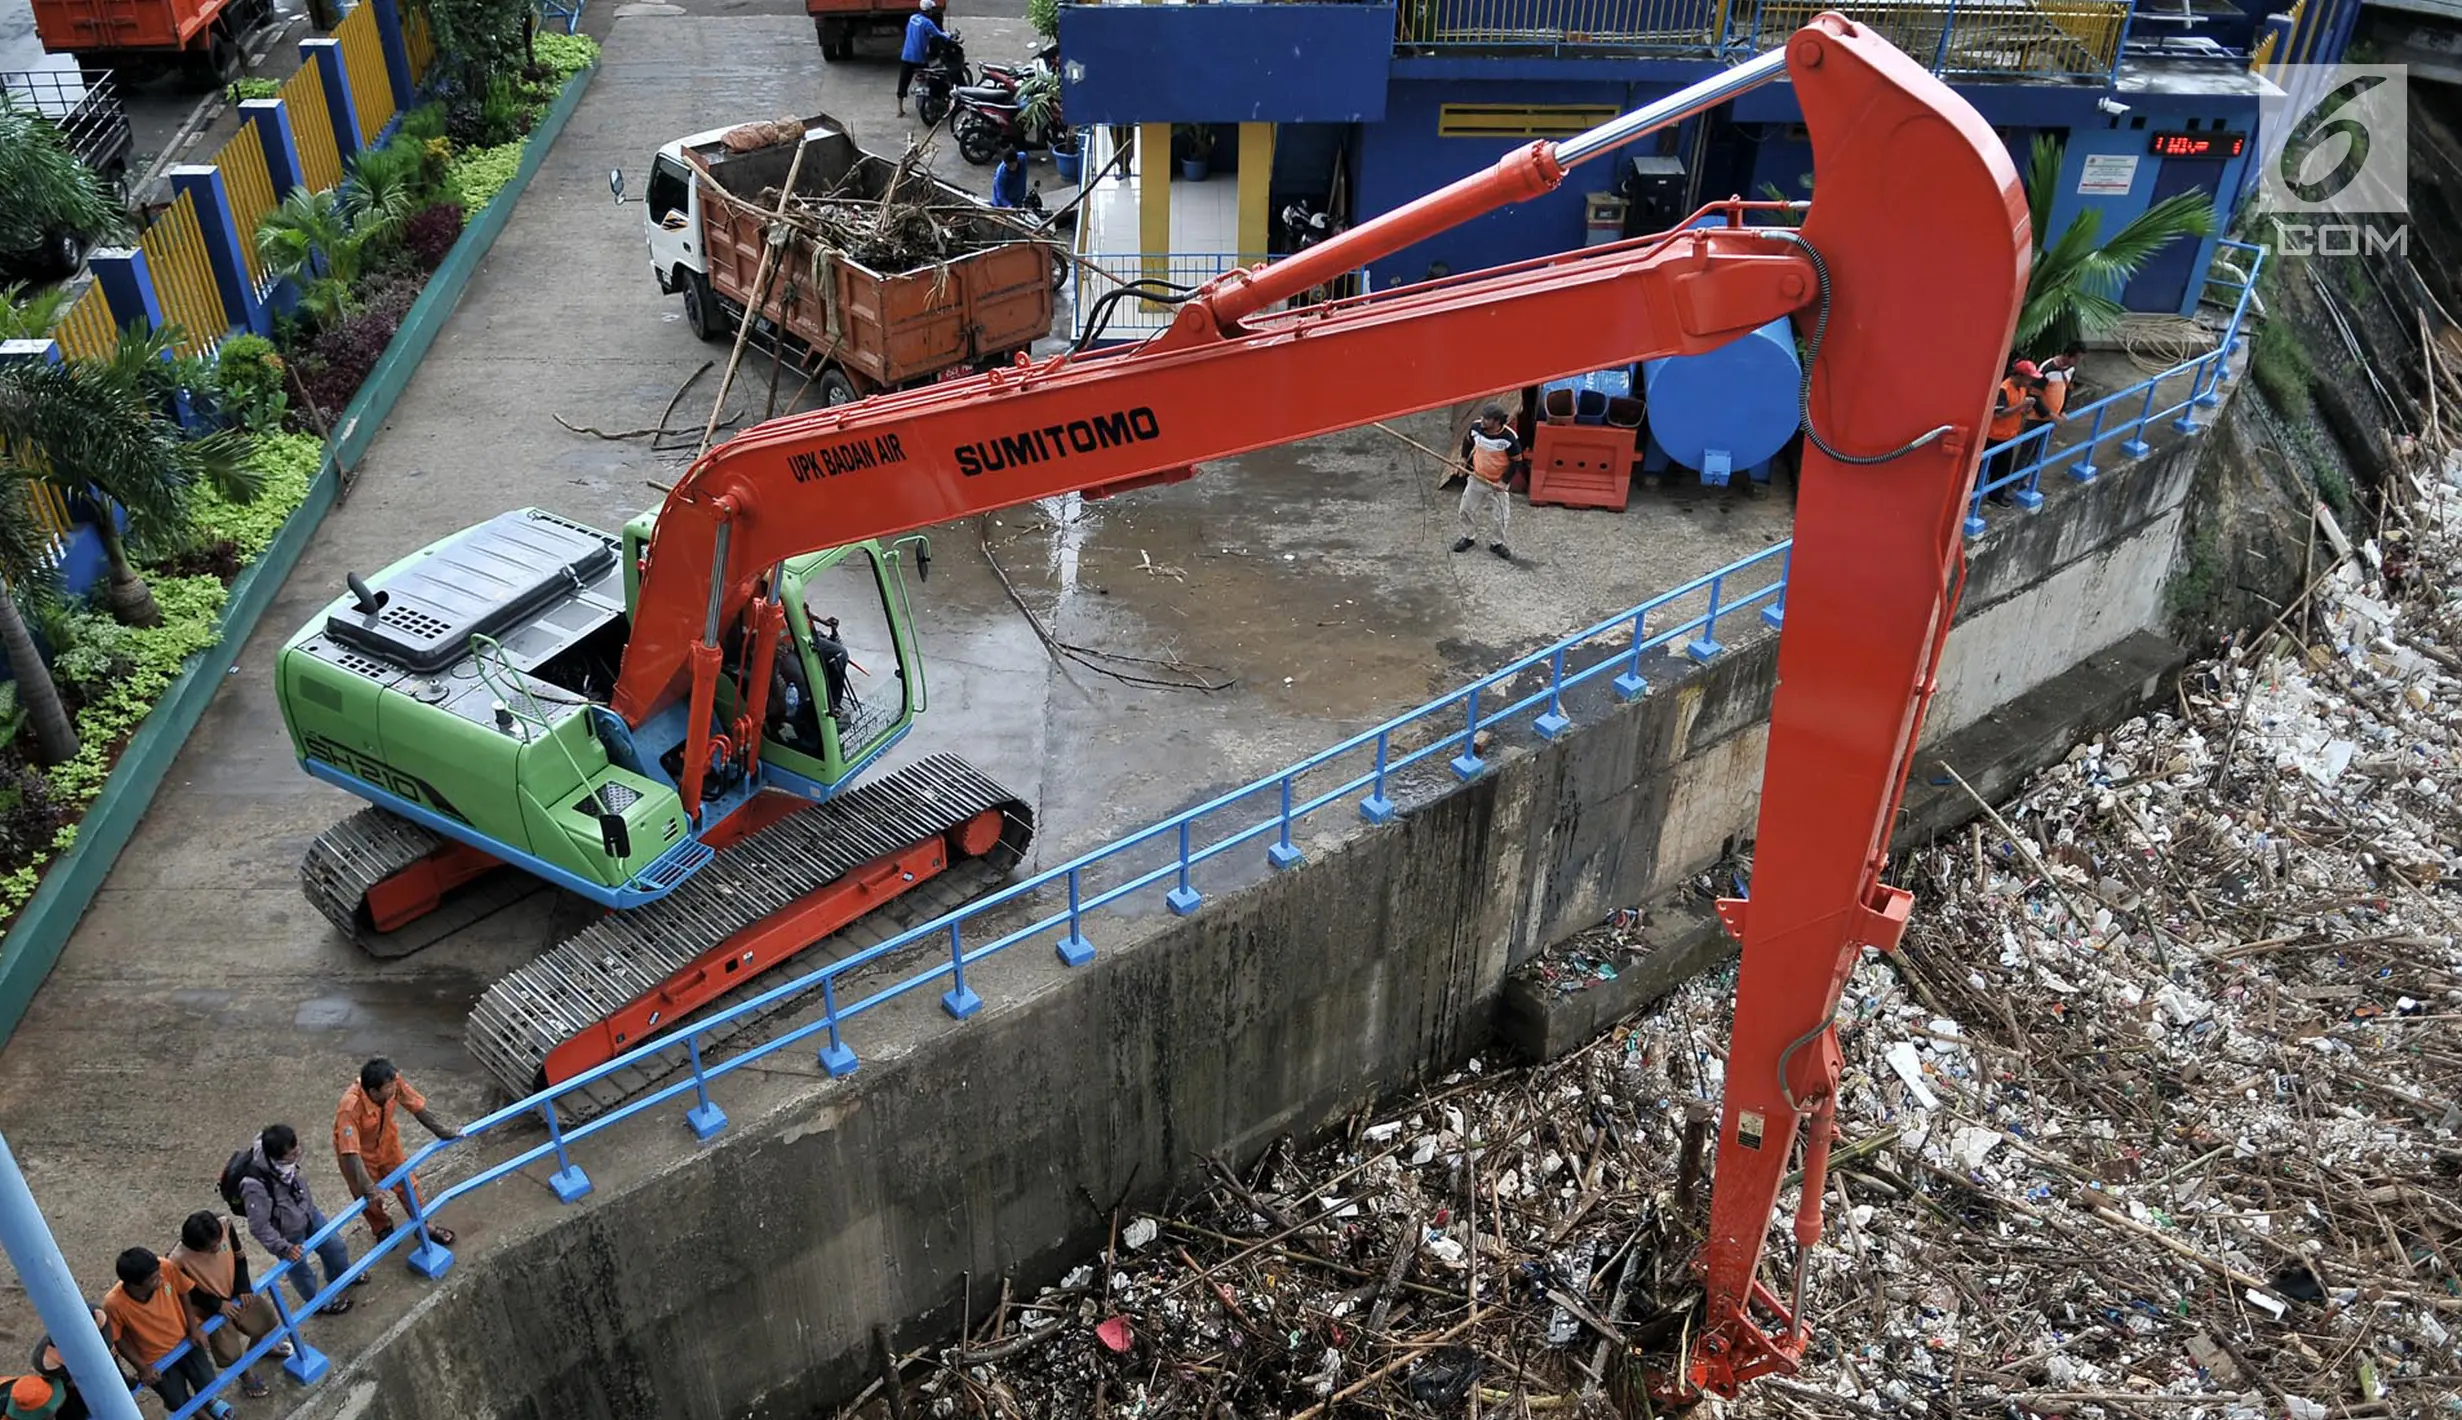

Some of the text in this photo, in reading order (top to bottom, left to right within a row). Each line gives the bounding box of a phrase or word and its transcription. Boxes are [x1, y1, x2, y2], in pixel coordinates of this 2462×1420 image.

[786, 432, 907, 484] UPK BADAN AIR
[954, 406, 1160, 478] SUMITOMO
